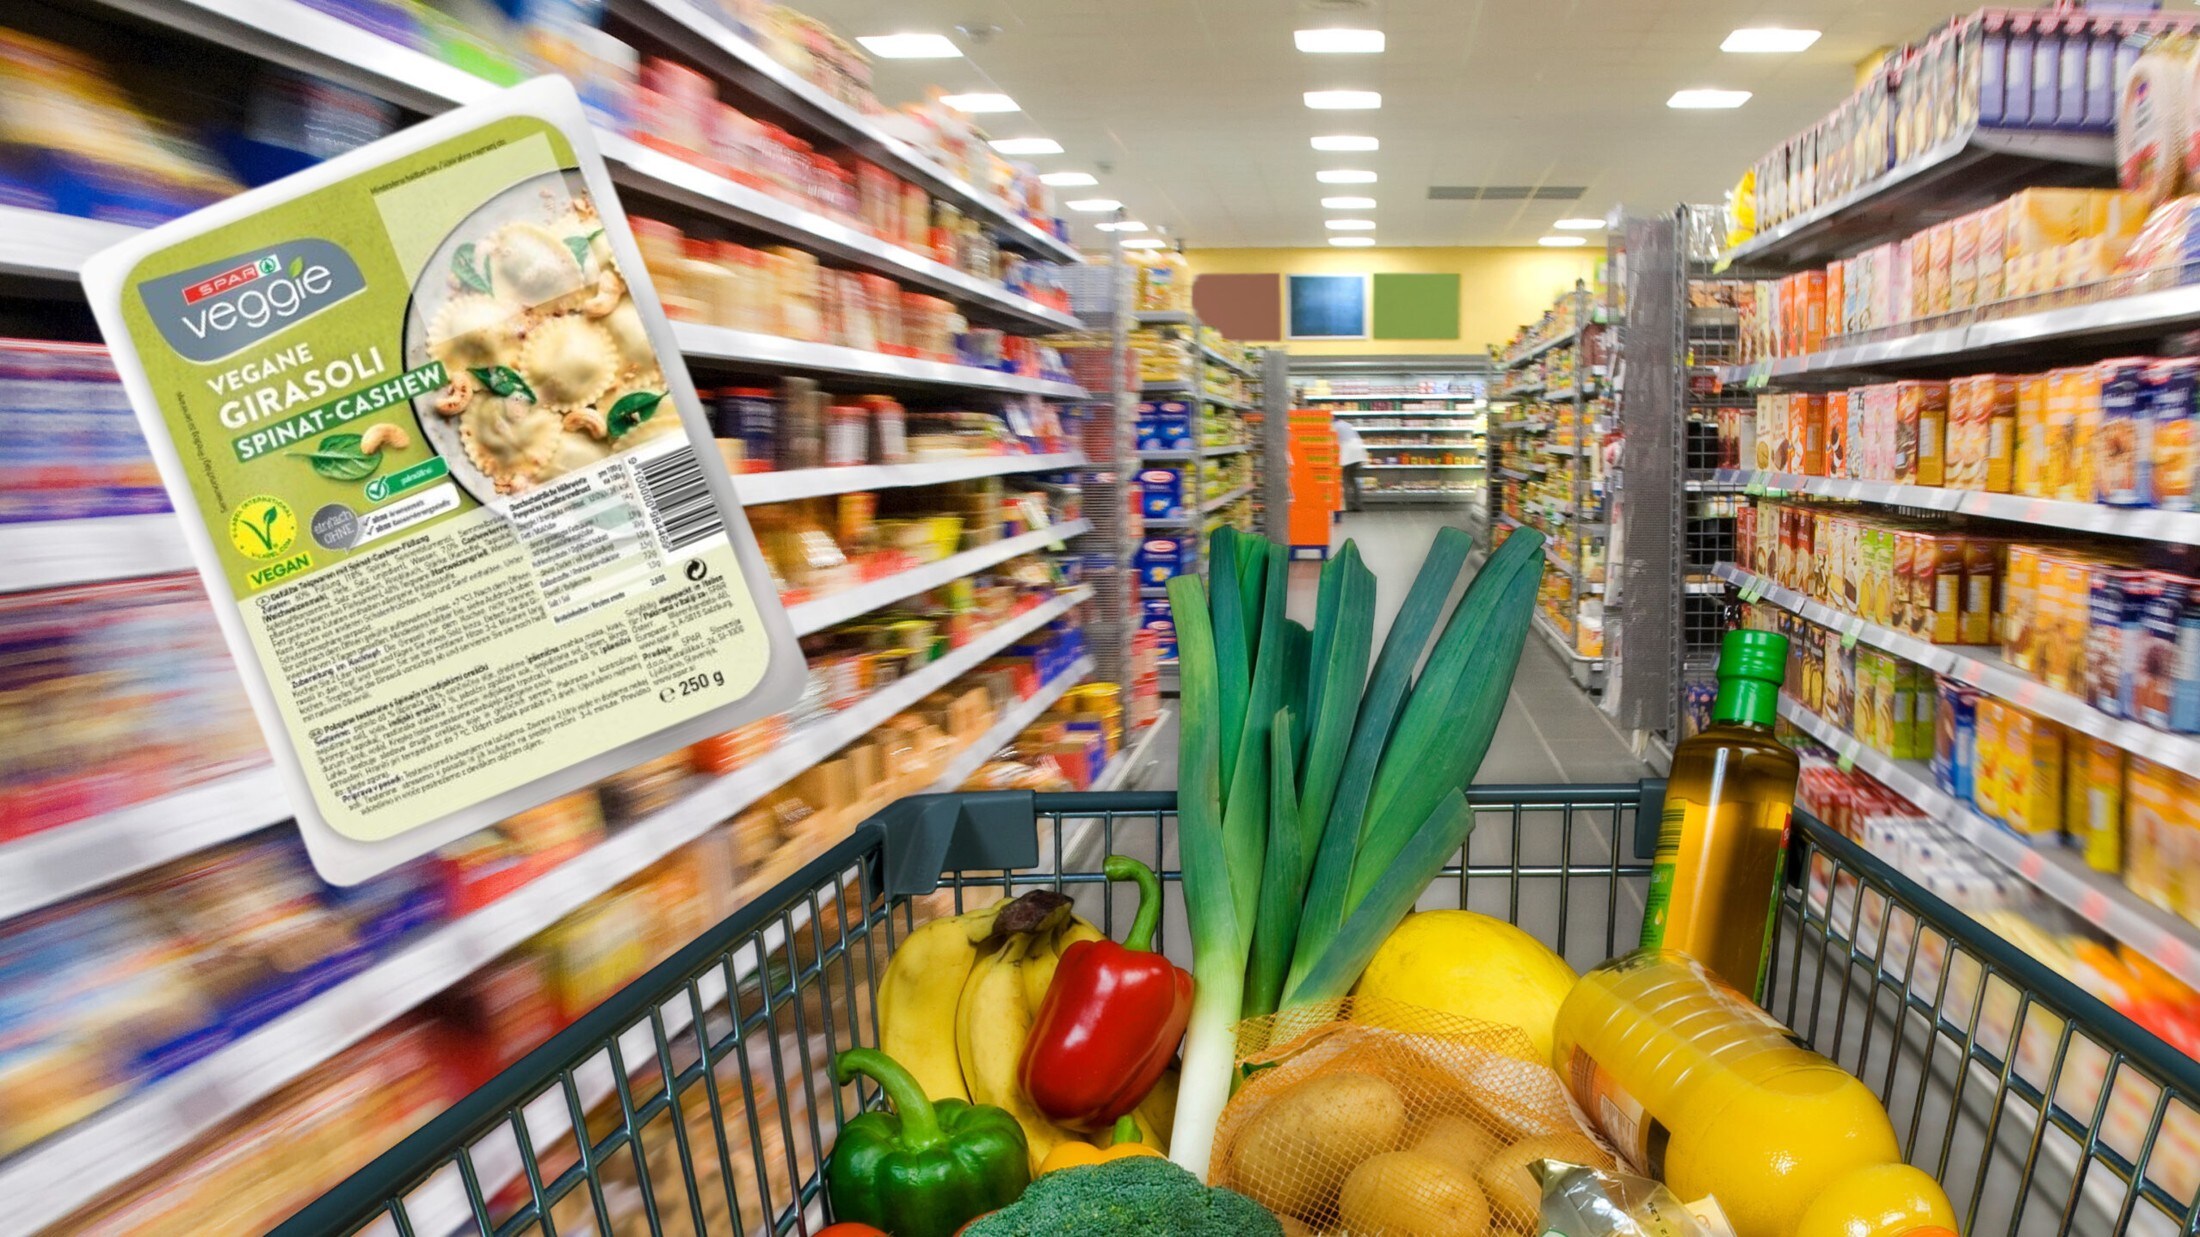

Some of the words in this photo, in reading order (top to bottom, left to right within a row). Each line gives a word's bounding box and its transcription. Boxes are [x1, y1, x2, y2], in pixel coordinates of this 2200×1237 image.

[200, 268, 257, 296] SPAR
[182, 265, 332, 339] veggie
[207, 342, 314, 396] VEGANE
[219, 347, 385, 429] GIRASOLI
[237, 364, 441, 460] SPINAT-CASHEW
[313, 509, 353, 536] einfach
[323, 526, 355, 545] OHNE
[250, 553, 310, 585] VEGAN
[678, 673, 710, 698] 250
[713, 670, 725, 687] g
